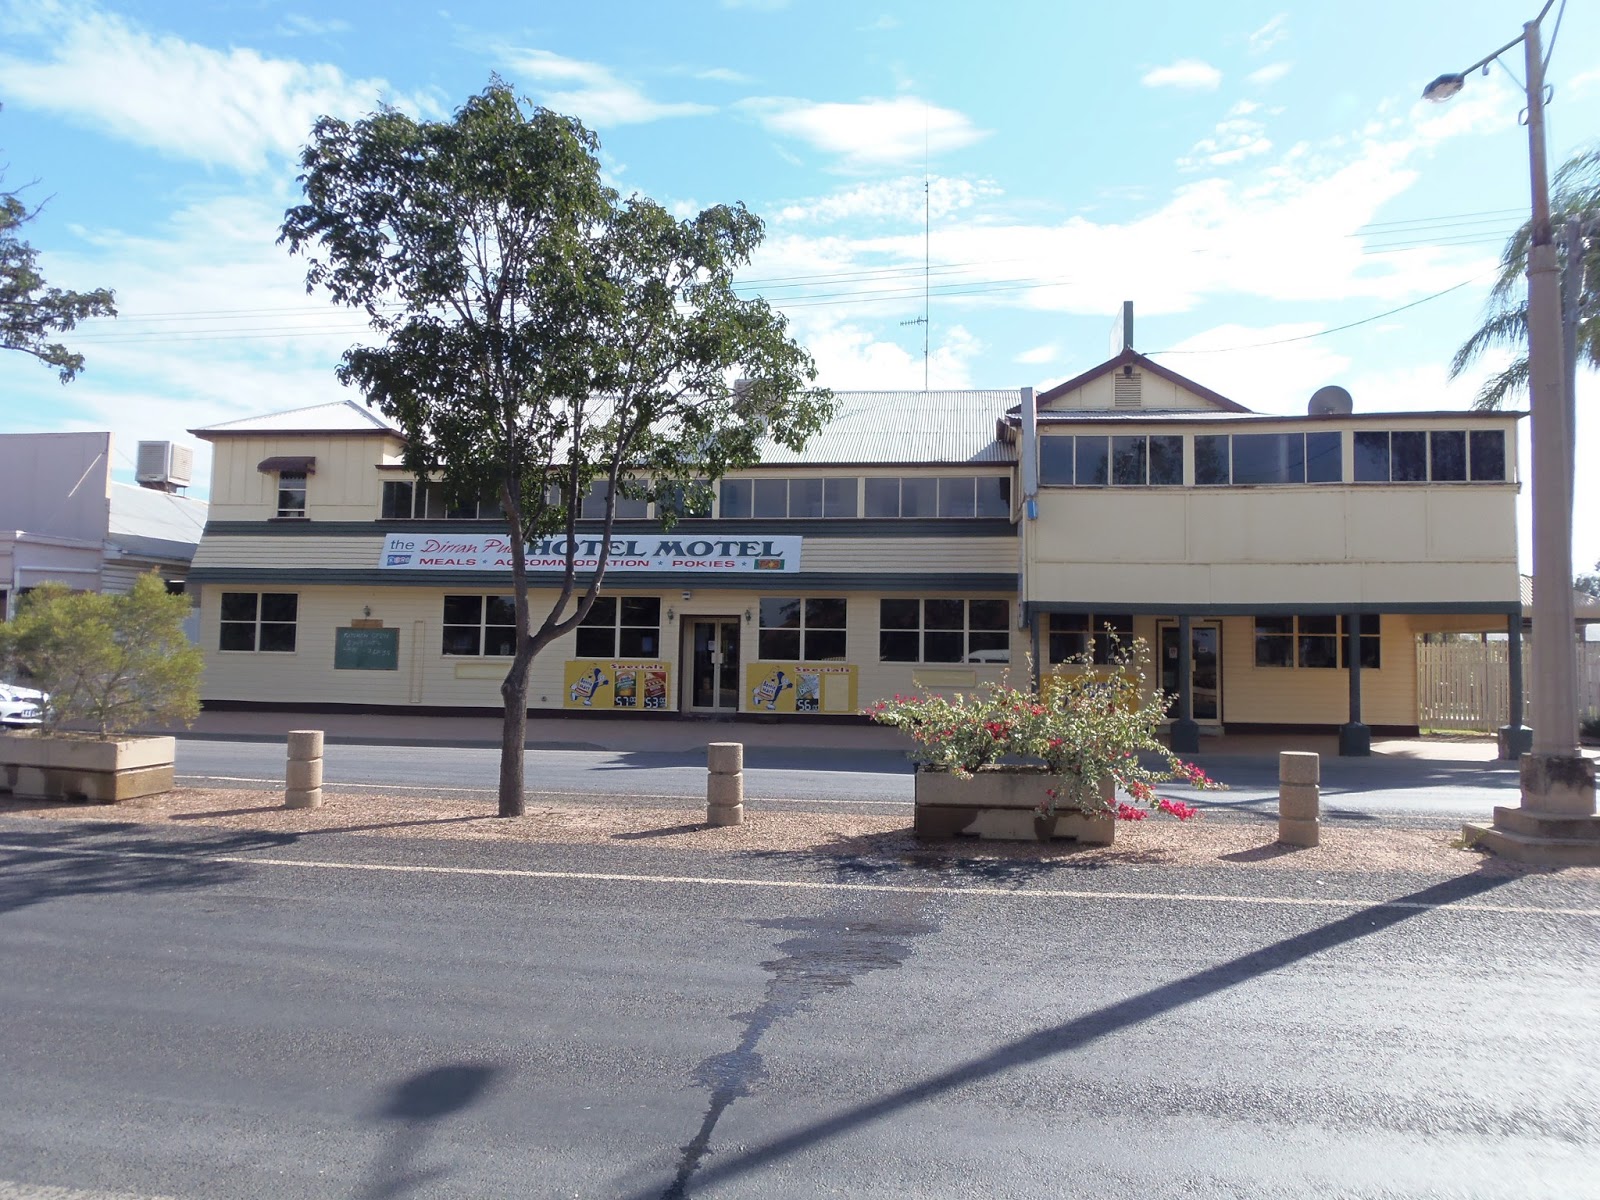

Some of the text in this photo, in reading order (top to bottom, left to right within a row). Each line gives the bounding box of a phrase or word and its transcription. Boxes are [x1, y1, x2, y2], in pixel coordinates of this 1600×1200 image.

[390, 538, 513, 554] the Dirran Pu
[525, 540, 783, 558] HOTEL MOTEL
[419, 558, 476, 566] MEALS
[672, 560, 735, 568] POKIES
